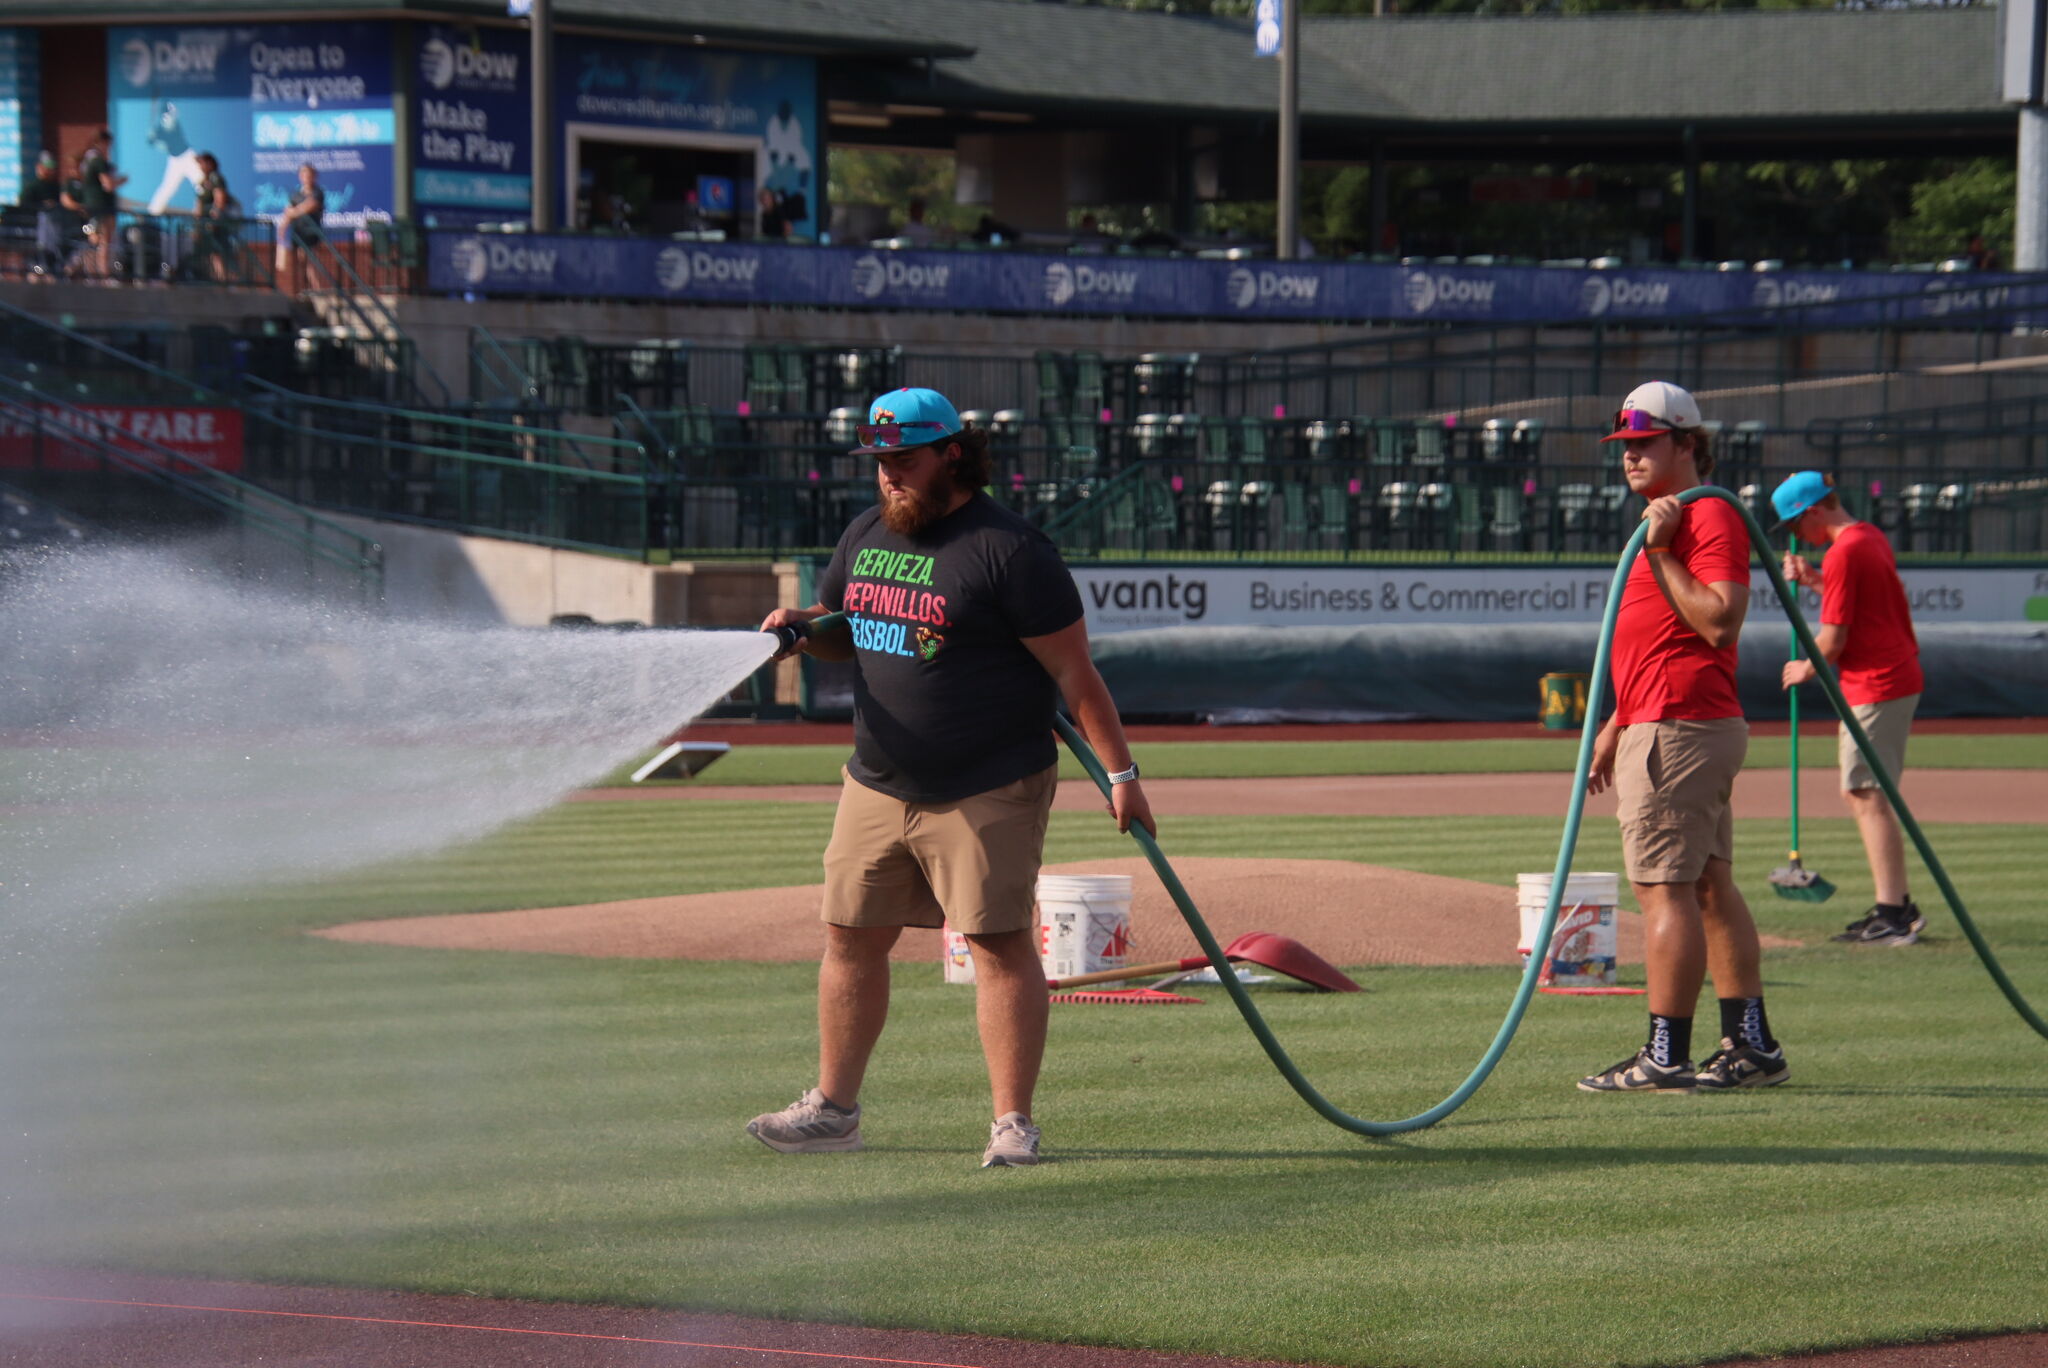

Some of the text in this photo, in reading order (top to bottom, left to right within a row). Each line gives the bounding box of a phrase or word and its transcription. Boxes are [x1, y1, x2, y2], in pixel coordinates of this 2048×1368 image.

[251, 42, 345, 76] Open to
[251, 73, 366, 103] Everyone
[422, 98, 487, 132] Make
[422, 131, 515, 170] the Play
[852, 548, 935, 586] CERVEZA.
[843, 582, 953, 627] PEPINILLOS.
[1089, 573, 1208, 620] vantg
[1250, 581, 1373, 611] Business
[1379, 581, 1399, 611] &
[1406, 580, 1576, 611] Commercial
